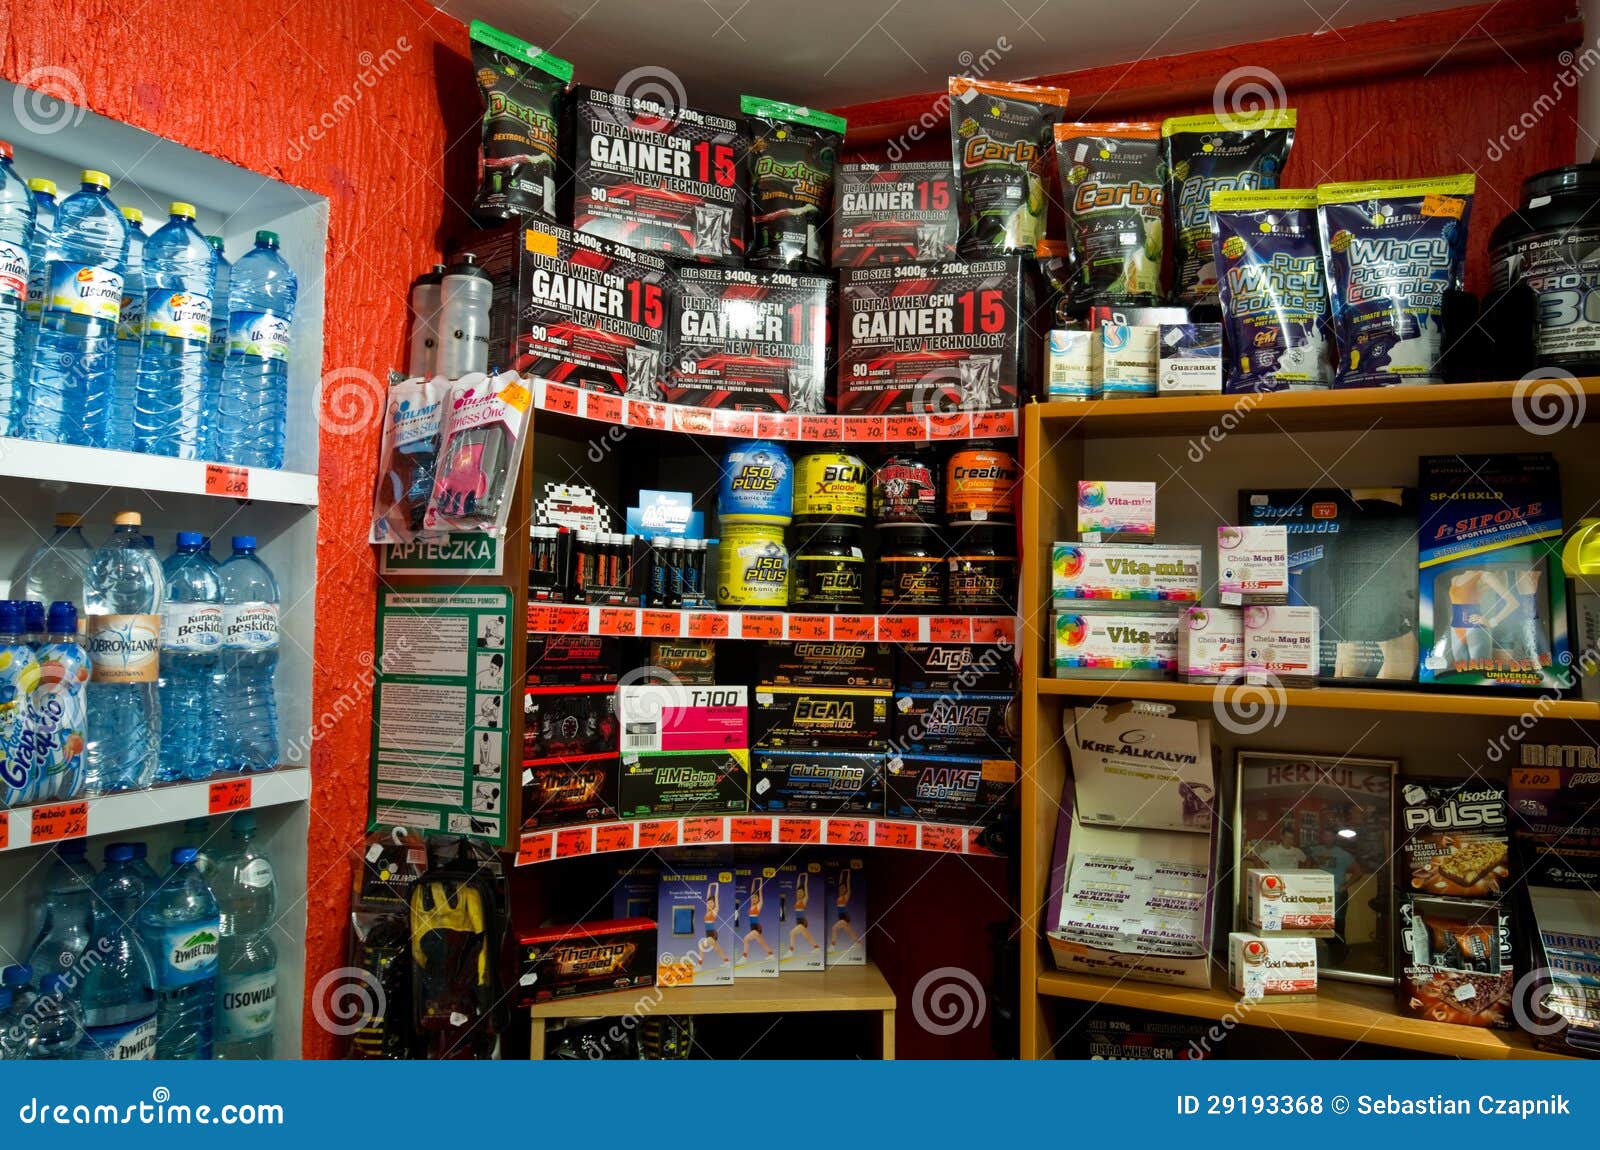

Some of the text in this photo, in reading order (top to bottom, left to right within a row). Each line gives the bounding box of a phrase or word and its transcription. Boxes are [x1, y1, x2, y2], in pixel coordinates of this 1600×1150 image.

[590, 89, 737, 131] BIG SIZE 200g GRATIS
[591, 119, 691, 152] ULTRA WHEY CFM
[590, 134, 737, 189] GAINER 15
[860, 163, 880, 172] 920g
[591, 187, 607, 202] 90
[633, 170, 737, 203] NEW TECHNOLOGY
[896, 182, 914, 192] CFM
[842, 181, 950, 212] GAINER 15
[893, 210, 949, 221] TECHNOLOGY
[842, 228, 853, 238] 23
[1529, 234, 1600, 251] Quality Sport
[573, 231, 665, 270] 3400g 200g GRATIS
[1350, 237, 1450, 266] Whey
[534, 253, 625, 291] ULTRA WHEY CFM
[681, 268, 798, 288] BIG SIZE 3400g 200g
[852, 261, 1006, 281] BIG SIZE 3400g 200g GRATIS
[1351, 262, 1429, 283] Protein
[1230, 266, 1325, 299] Whey
[1348, 280, 1449, 302] Complex
[532, 268, 664, 329] GAINER 15
[852, 293, 954, 313] ULTRA WHEY CFM
[1231, 294, 1304, 315] Isolate
[852, 290, 1006, 339] GAINER 15
[532, 325, 547, 342] 90
[572, 308, 663, 345] NEW TECHNOLOGY
[725, 340, 753, 355] NEW
[894, 333, 1006, 353] NEW TECHNOLOGY
[681, 361, 697, 375] 90
[852, 363, 867, 377] 90
[1170, 363, 1217, 372] Guaranax
[742, 466, 772, 478] ISO
[732, 478, 779, 491] PLUS
[1252, 502, 1303, 518] Short
[1456, 525, 1499, 542] SPORTING
[1499, 519, 1529, 532] GOODS
[391, 540, 491, 560] APTECZKA
[756, 558, 783, 569] ISO
[1105, 557, 1199, 576] Vita-min
[745, 570, 787, 583] PLUS
[658, 645, 708, 659] Thermo
[794, 642, 865, 657] Creatine
[1454, 656, 1503, 673] WAIST
[1486, 671, 1539, 681] UNIVERSAL
[692, 690, 738, 707] T-100
[794, 700, 854, 721] BCAA
[927, 704, 992, 726] AAKG
[1081, 738, 1197, 765] KRE-ALKALYN
[789, 763, 864, 779] Glutamine
[917, 767, 982, 790] AAKG
[1266, 763, 1390, 793] HERKULES
[830, 779, 862, 791] 1400
[916, 786, 947, 798] 1250
[1281, 895, 1298, 904] Gold
[1298, 895, 1326, 905] Omega
[558, 943, 625, 962] Thermo
[572, 958, 613, 972] speed
